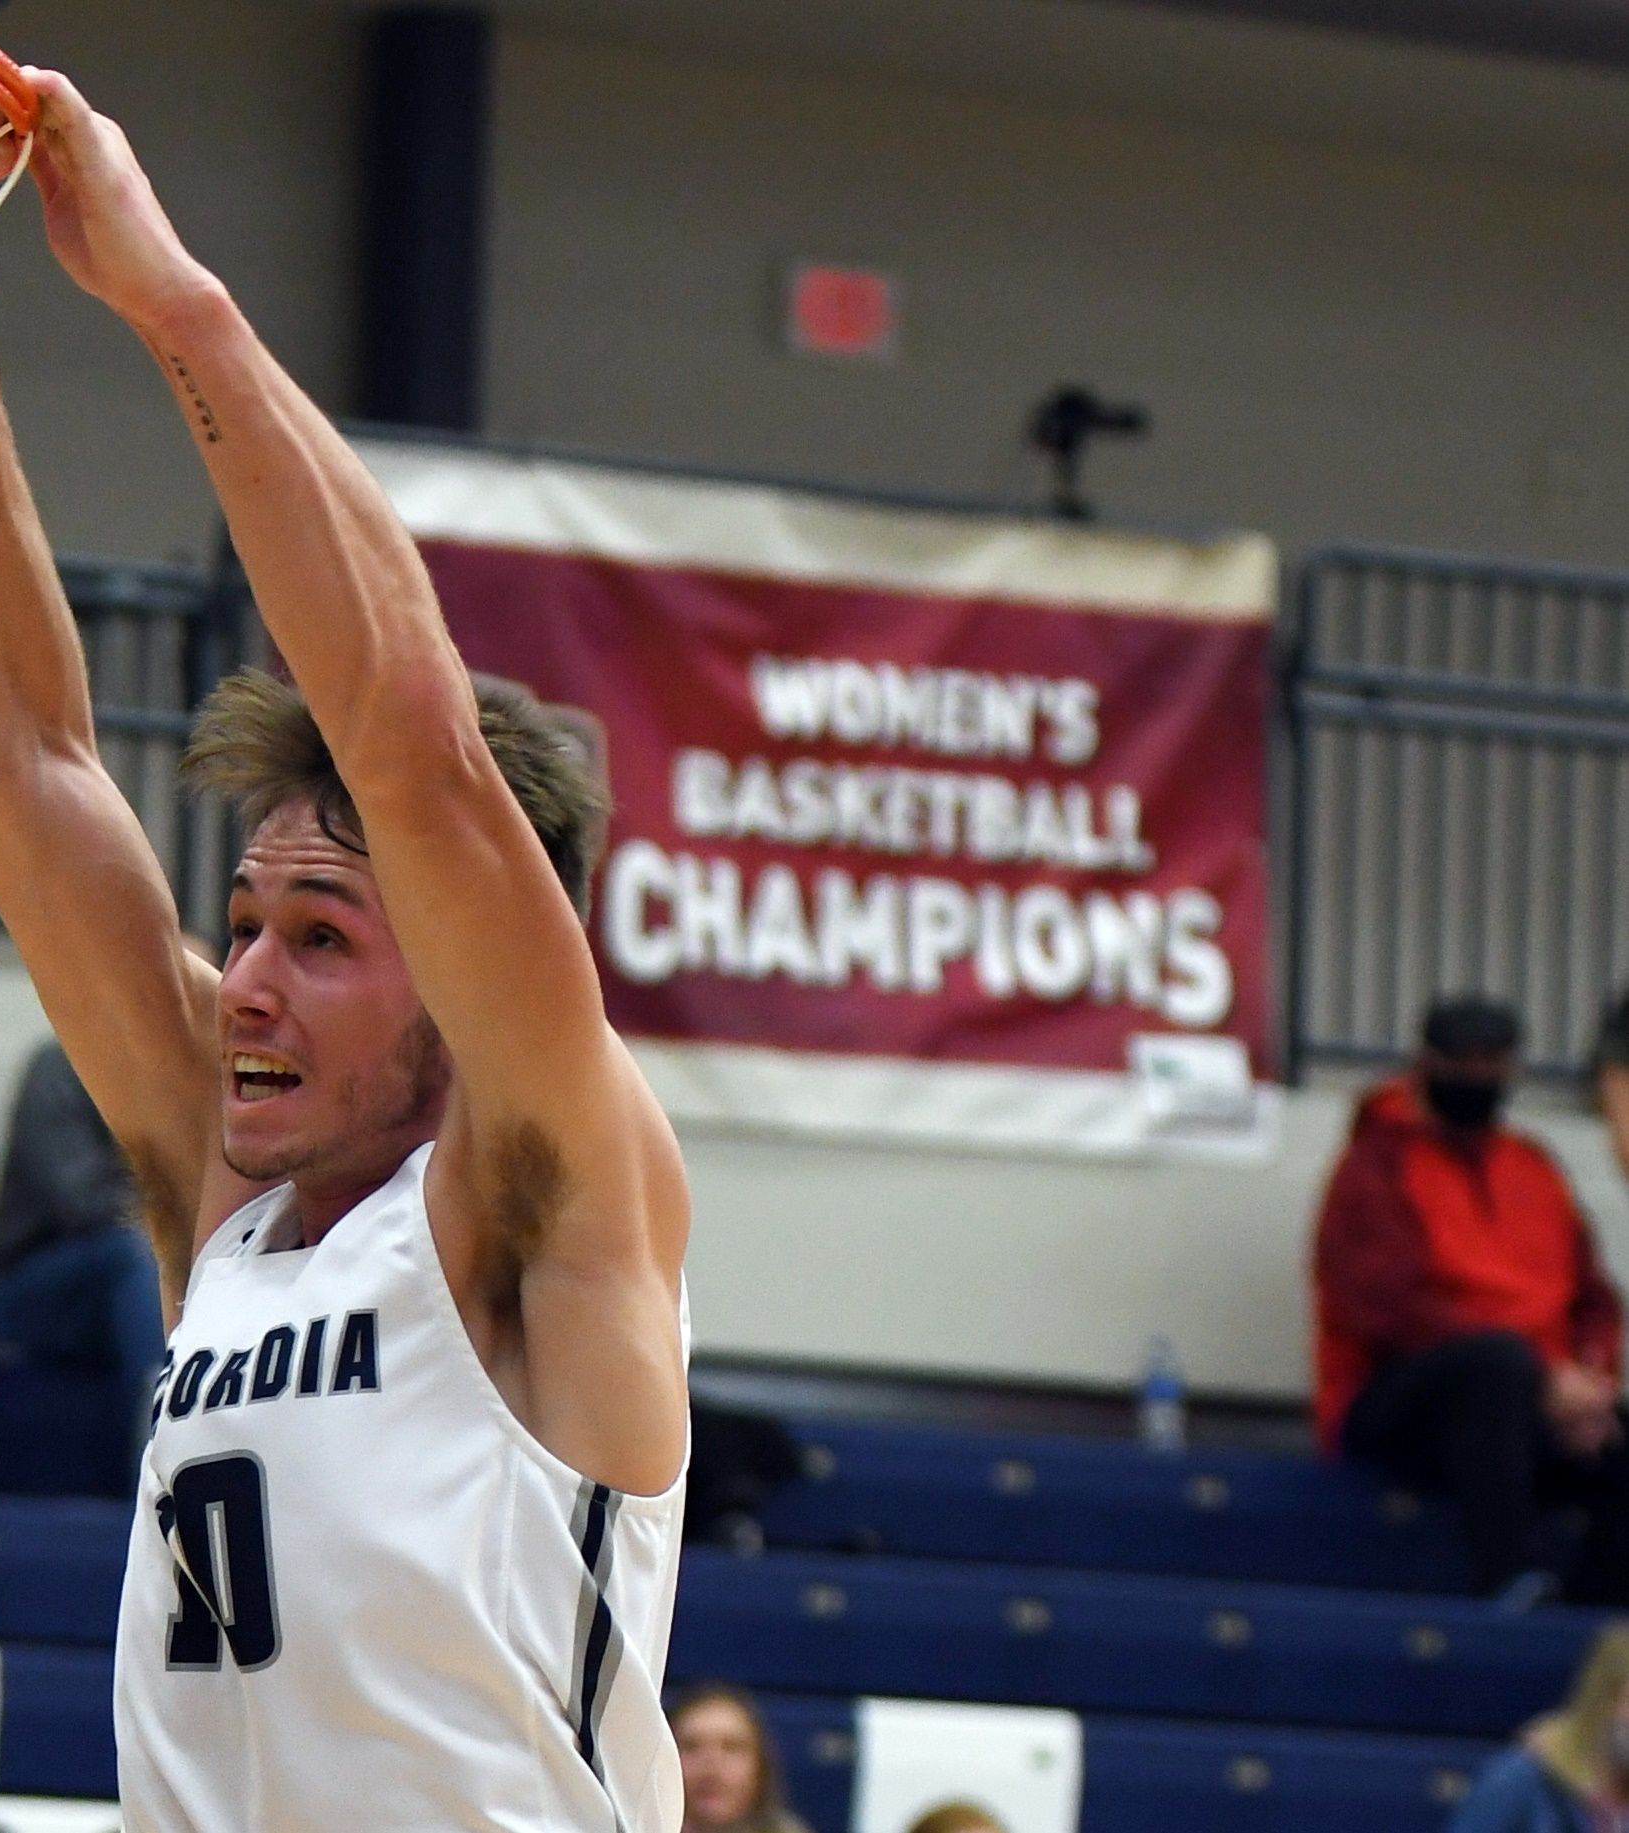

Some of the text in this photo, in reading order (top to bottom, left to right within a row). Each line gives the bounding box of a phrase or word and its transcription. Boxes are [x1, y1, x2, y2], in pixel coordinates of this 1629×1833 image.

[750, 656, 1098, 764] WOMEN'S
[674, 749, 1153, 871] BASKETBALL
[605, 839, 1231, 1025] CHAMPIONS
[156, 1449, 282, 1673] 10
